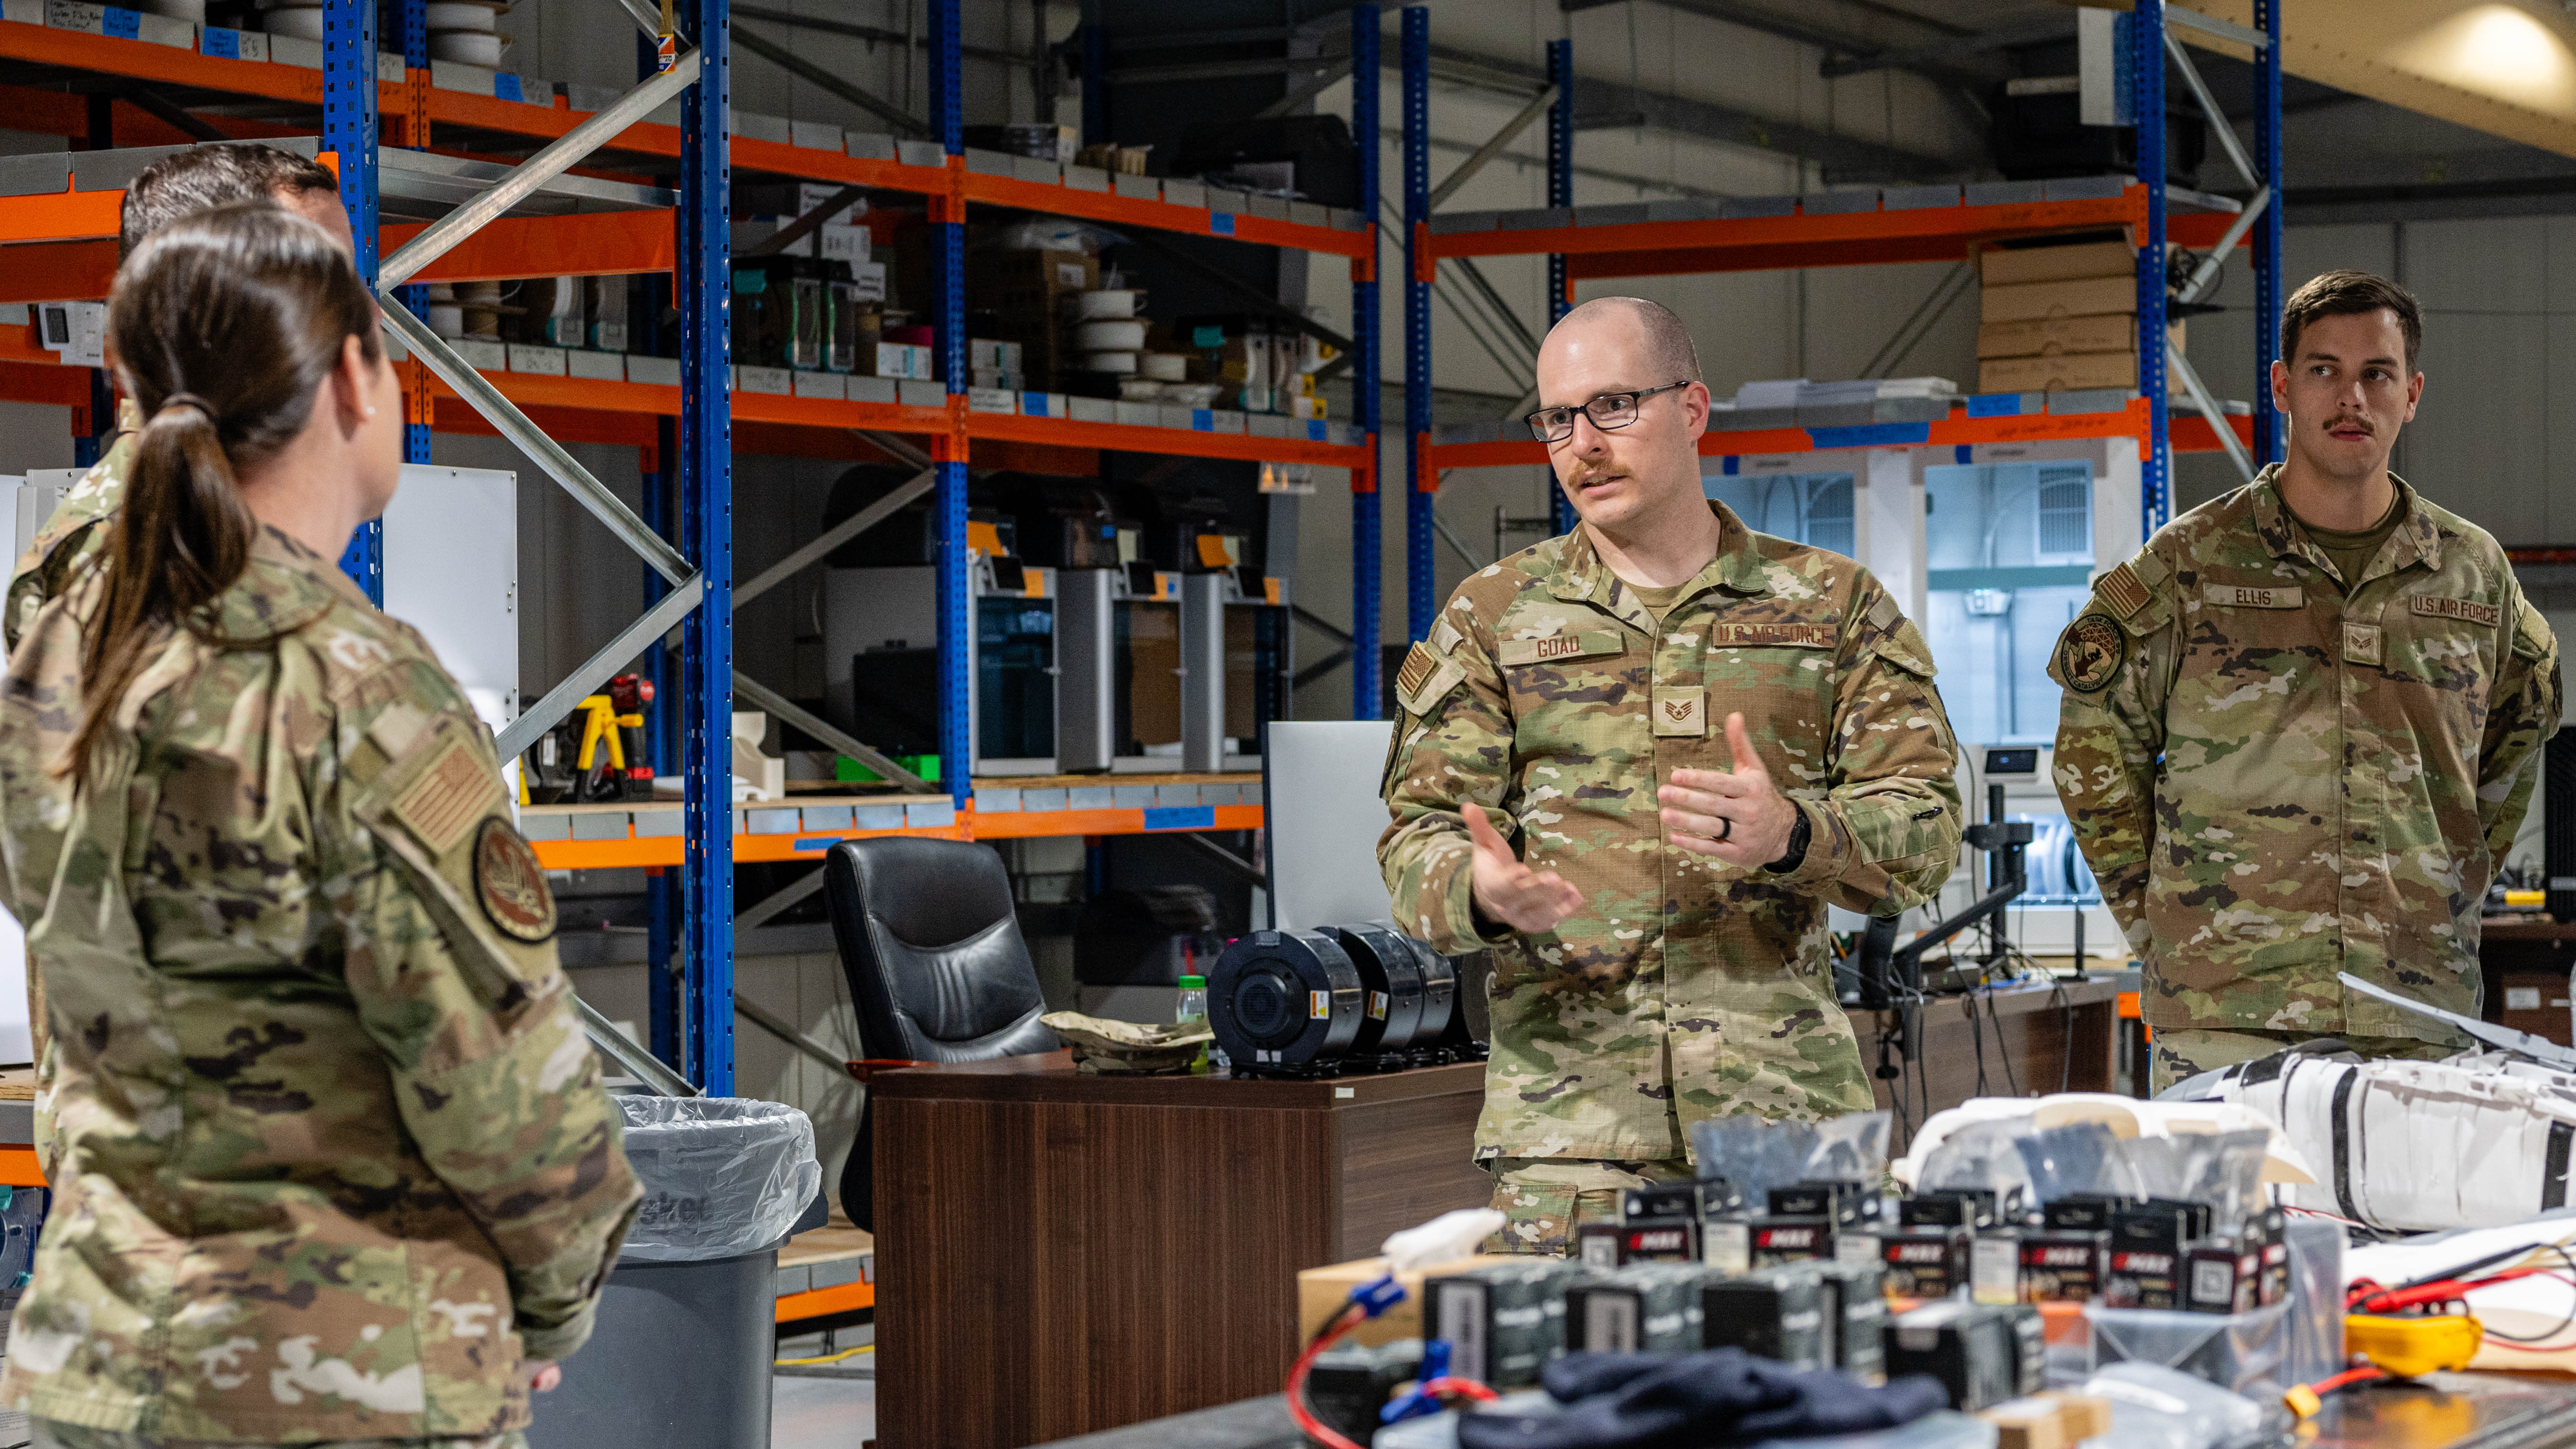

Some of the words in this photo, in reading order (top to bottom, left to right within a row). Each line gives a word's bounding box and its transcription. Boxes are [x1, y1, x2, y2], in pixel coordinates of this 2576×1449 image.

[2236, 589, 2271, 605] ELLIS
[2415, 596, 2437, 613] U.S.
[2439, 599, 2458, 616] AIR
[2461, 601, 2498, 624] FORCE
[1537, 635, 1580, 657] GOAD
[1752, 625, 1775, 642] AIR
[1780, 625, 1833, 645] FORCE
[2063, 650, 2075, 681] DESERT
[2073, 678, 2104, 689] CATALYST
